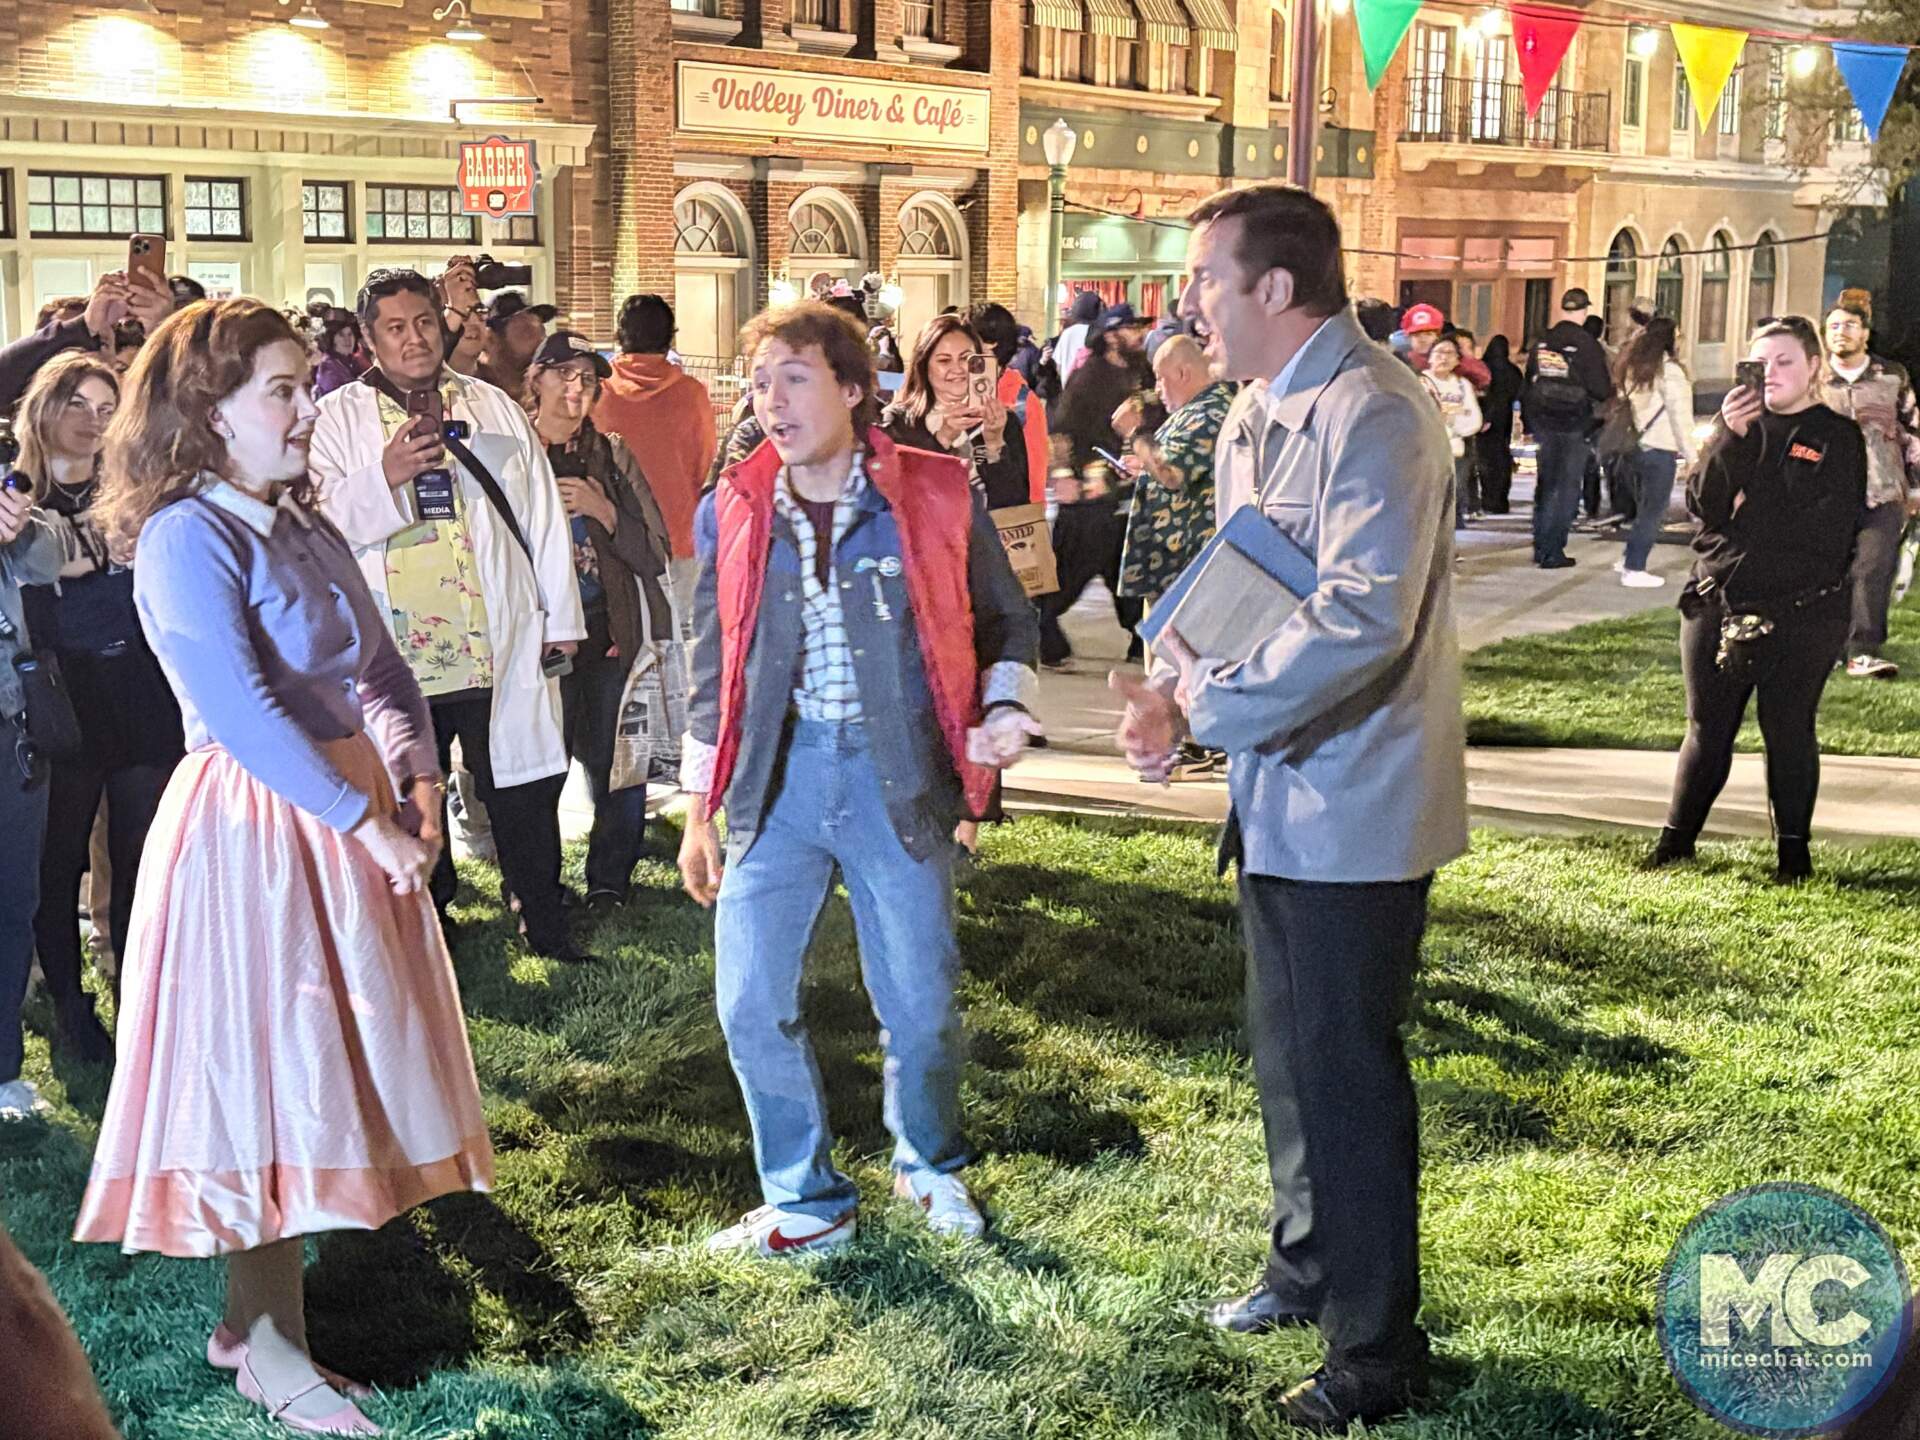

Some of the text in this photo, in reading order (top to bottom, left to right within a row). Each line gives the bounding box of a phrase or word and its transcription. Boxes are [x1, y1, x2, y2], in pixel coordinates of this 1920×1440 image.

[711, 77, 964, 135] Valley Diner & Café
[464, 145, 527, 188] BARBER
[423, 506, 450, 514] MEDIA
[999, 525, 1034, 541] ANTED
